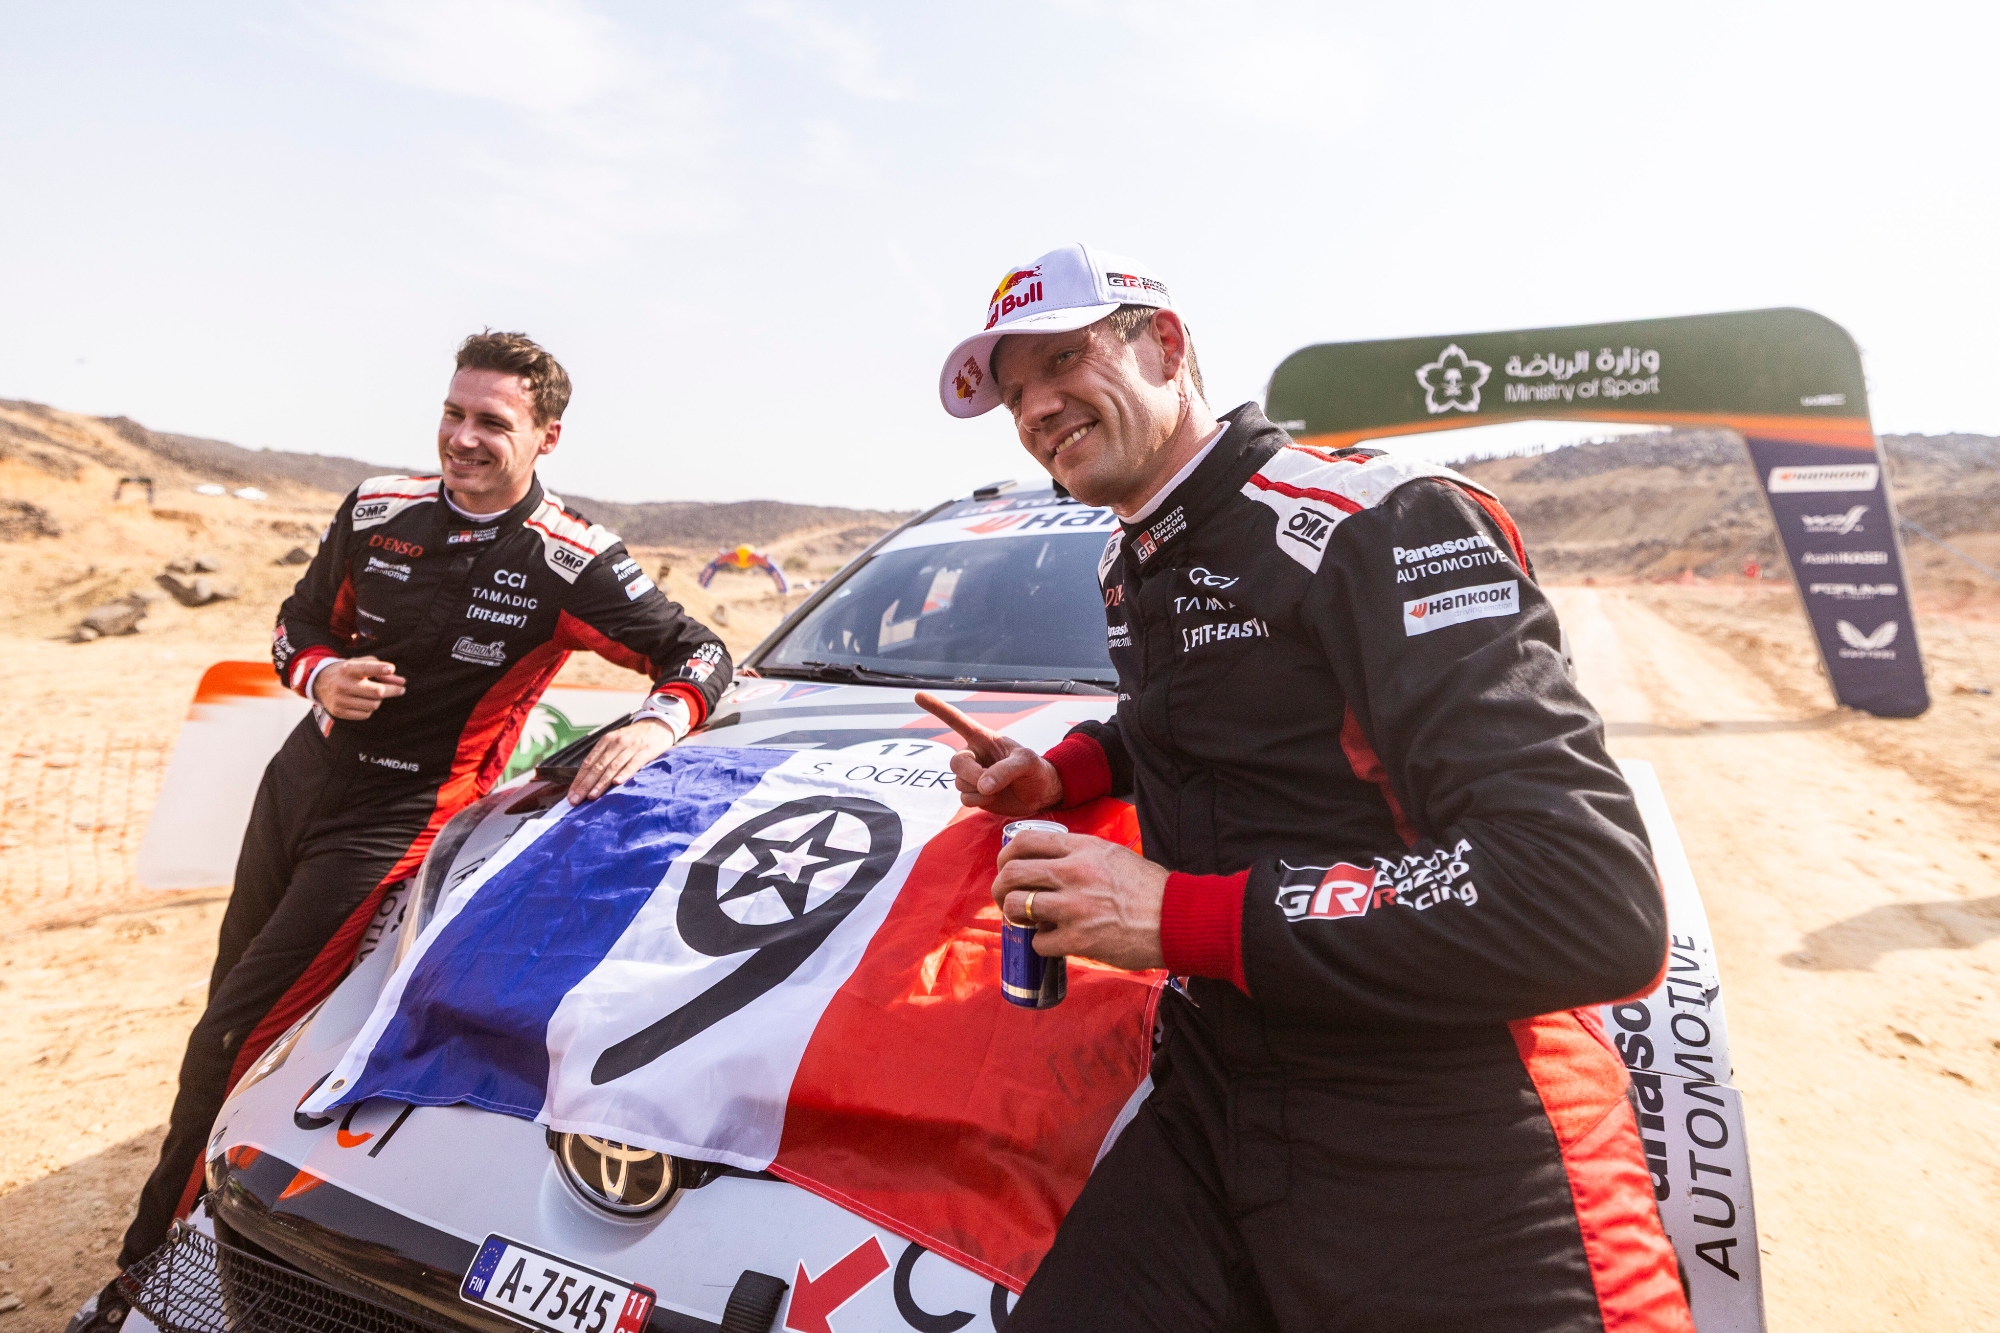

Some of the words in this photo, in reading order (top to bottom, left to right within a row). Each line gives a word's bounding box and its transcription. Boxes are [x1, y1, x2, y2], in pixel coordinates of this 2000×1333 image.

[1002, 281, 1042, 316] Bull
[1505, 351, 1590, 380] الرياضة
[1596, 346, 1660, 377] وزارة
[1504, 382, 1575, 402] Ministry
[1577, 378, 1598, 398] of
[1602, 375, 1660, 399] Sport
[355, 505, 388, 518] OMP
[1150, 505, 1184, 533] TOYOTA
[1153, 514, 1184, 540] GAZOO
[1156, 521, 1187, 547] Racing
[368, 534, 424, 558] DENSO
[554, 549, 584, 570] OMP
[1137, 540, 1156, 560] GR
[1397, 549, 1509, 584] AUTOMOTIVE
[472, 587, 538, 610] TAMADIC
[1454, 604, 1483, 617] driving
[1484, 602, 1513, 613] emotion
[879, 743, 934, 756] 17
[370, 756, 420, 772] LANDAIS
[802, 762, 832, 776] S.
[845, 765, 956, 790] OGIER
[1373, 838, 1472, 879] TOYOTA
[1374, 861, 1470, 894] GAZOO
[1276, 879, 1368, 918] GR
[1666, 934, 1740, 1282] AUTOMOTIVE
[468, 1275, 486, 1293] FIN
[496, 1257, 616, 1333] A-7545
[627, 1292, 649, 1320] 11
